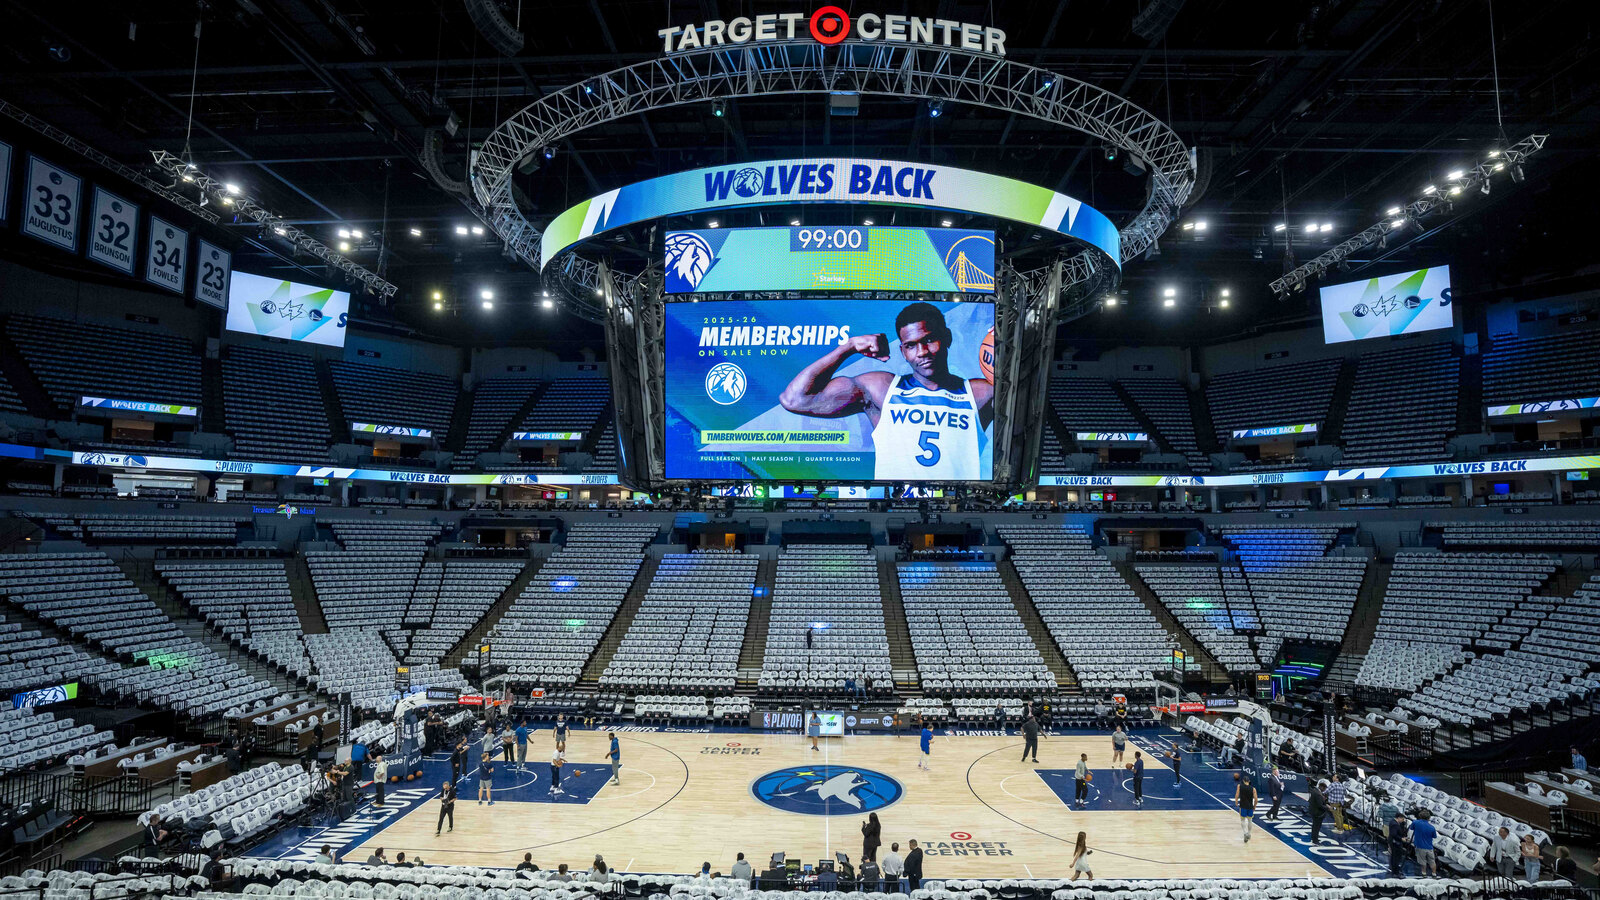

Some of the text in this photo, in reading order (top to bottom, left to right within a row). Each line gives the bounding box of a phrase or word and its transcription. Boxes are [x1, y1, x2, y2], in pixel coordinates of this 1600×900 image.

[658, 13, 1006, 56] TARGET CENTER
[704, 164, 936, 202] WOLVES BACK
[33, 185, 72, 226] 33
[29, 216, 73, 241] AUGUSTUS
[98, 214, 130, 251] 32
[798, 229, 862, 249] 99:00
[94, 242, 130, 264] BRUNSON
[153, 239, 182, 274] 34
[153, 267, 179, 284] FOWLES
[202, 261, 225, 291] 23
[820, 275, 846, 284] Starkey
[202, 287, 222, 302] MOORE
[703, 316, 757, 324] 2025-26
[698, 325, 851, 347] MEMBERSHIPS
[148, 402, 171, 413] BACK
[890, 409, 969, 431] WOLVES
[1279, 425, 1296, 434] BACK
[706, 432, 845, 443] TIMBERWOLVES.COM/MEMBERSHIPS
[915, 431, 941, 467] 5
[221, 462, 253, 473] PLAYOFFS
[1490, 460, 1528, 472] BACK
[428, 474, 451, 484] BACK
[585, 475, 608, 483] PLAYOFFS
[1091, 476, 1112, 485] BACK
[1257, 473, 1284, 483] PLAYOFFS
[252, 505, 276, 514] Treasure
[368, 758, 403, 769] cobase
[1261, 771, 1297, 781] cobase
